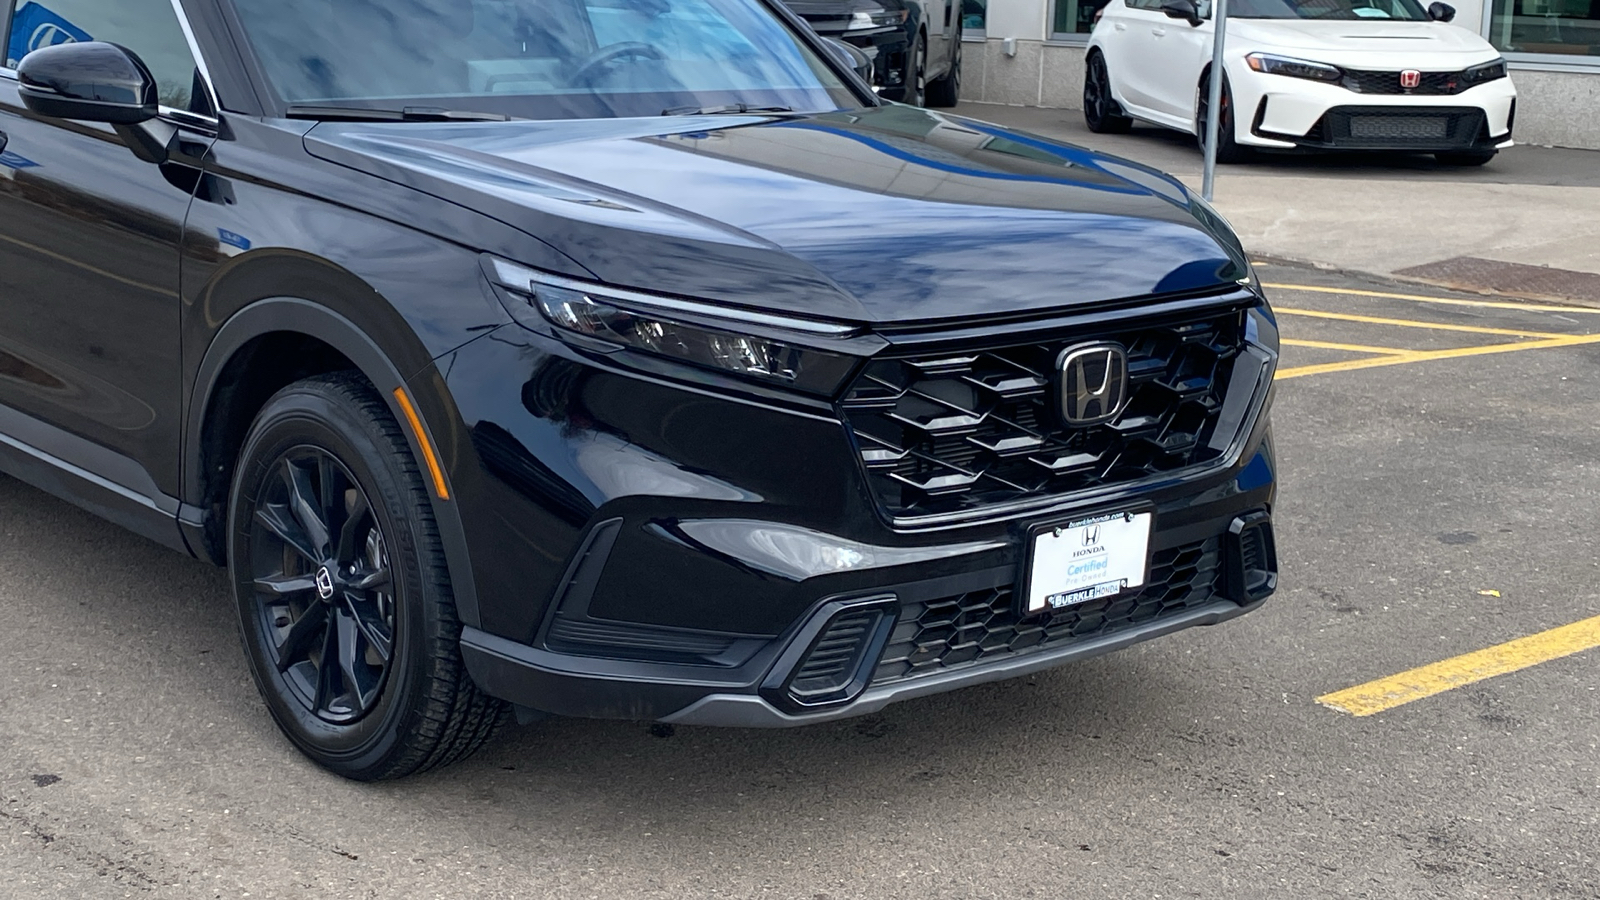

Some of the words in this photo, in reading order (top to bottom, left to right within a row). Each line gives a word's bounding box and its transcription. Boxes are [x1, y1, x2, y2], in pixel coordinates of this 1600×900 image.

[1068, 512, 1125, 528] buerklehonda.com
[1072, 546, 1106, 557] HONDA
[1067, 557, 1108, 576] Certified
[1081, 571, 1107, 582] Owned
